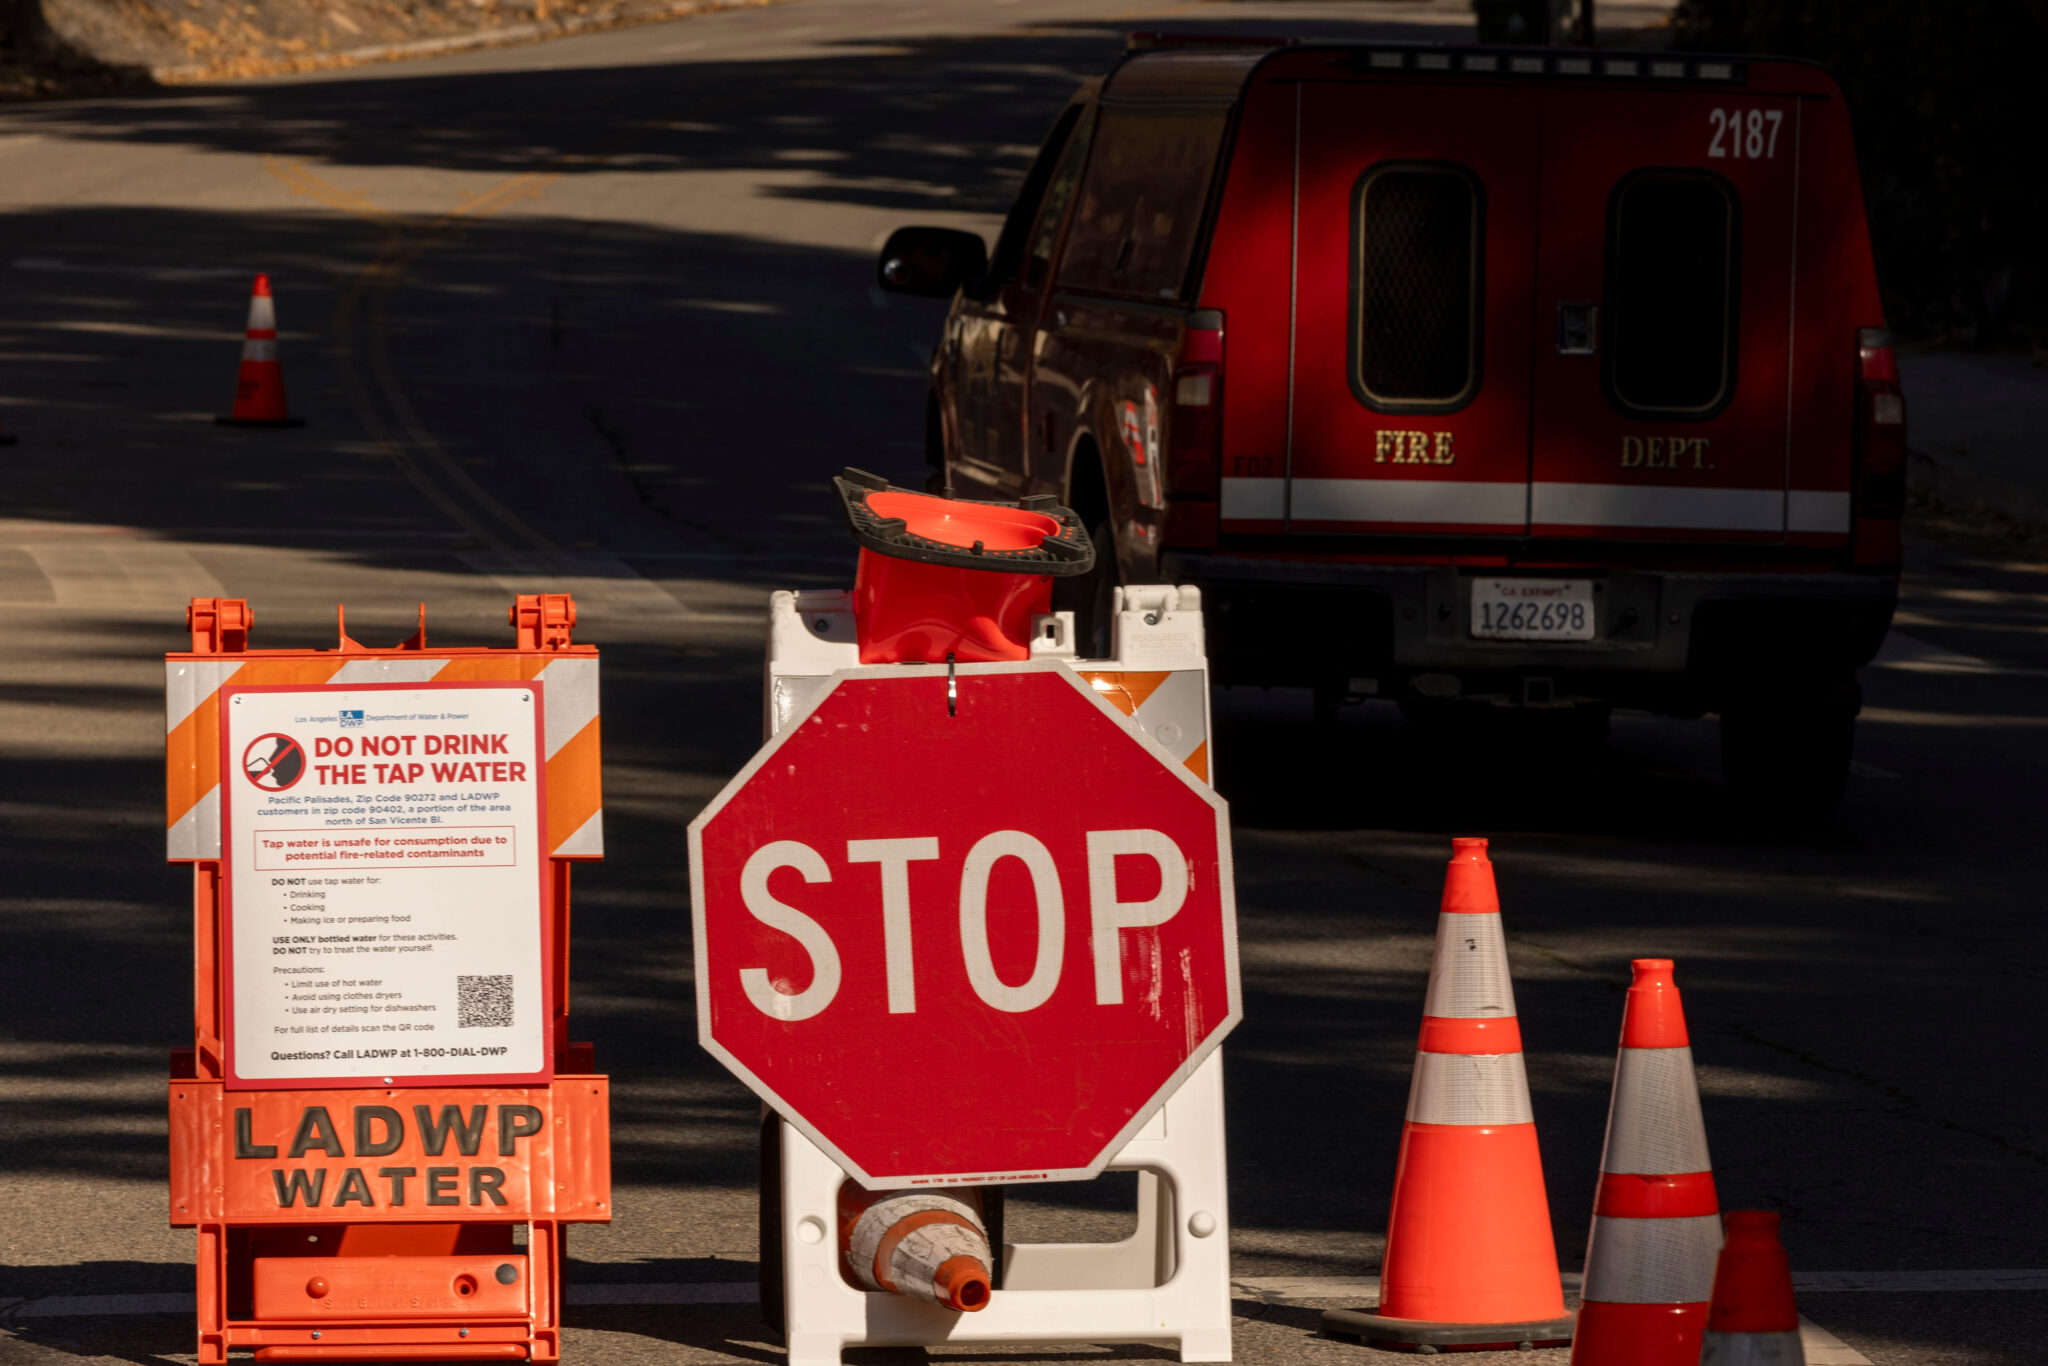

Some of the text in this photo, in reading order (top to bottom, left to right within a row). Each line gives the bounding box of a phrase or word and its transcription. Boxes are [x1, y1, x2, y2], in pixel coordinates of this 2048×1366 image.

[1707, 107, 1784, 160] 2187
[1374, 430, 1456, 465] FIRE
[1620, 435, 1715, 470] DEPT.
[1502, 587, 1562, 597] CA EXEMPT
[1480, 602, 1585, 631] 1262698
[340, 711, 353, 719] LA
[340, 719, 363, 728] DWP
[315, 734, 508, 757] DO NOT DRINK
[315, 762, 526, 785] THE TAP WATER
[269, 796, 301, 804] Pacific
[304, 796, 353, 804] Palisades,
[356, 795, 372, 803] Zip
[375, 794, 401, 802] Code
[439, 793, 457, 801] and
[324, 807, 338, 816] zip
[341, 806, 366, 814] code
[369, 805, 405, 814] 90402,
[417, 805, 454, 814] portion
[263, 840, 283, 849] Tap
[322, 839, 330, 847] is
[334, 838, 371, 847] unsafe
[375, 838, 390, 846] for
[393, 837, 468, 847] consumption
[471, 836, 493, 844] due
[286, 849, 484, 862] potential fire-related contaminants
[290, 891, 325, 900] Drinking
[290, 904, 325, 912] Cooking
[290, 917, 320, 925] Making
[348, 915, 389, 924] preparing
[391, 914, 411, 922] food
[739, 828, 1189, 1022] STOP
[309, 947, 321, 955] try
[398, 944, 434, 953] yourself.
[292, 993, 316, 1001] Avoid
[319, 993, 341, 1002] using
[376, 991, 402, 1000] dryers
[323, 1006, 337, 1014] dry
[339, 1005, 368, 1014] setting
[371, 1004, 383, 1012] for
[332, 1024, 359, 1032] details
[414, 1023, 434, 1031] code
[271, 1047, 507, 1061] Questions? Call LADWP at 1-800-DIAL-DWP
[234, 1104, 544, 1159] LADWP
[272, 1166, 508, 1208] WATER
